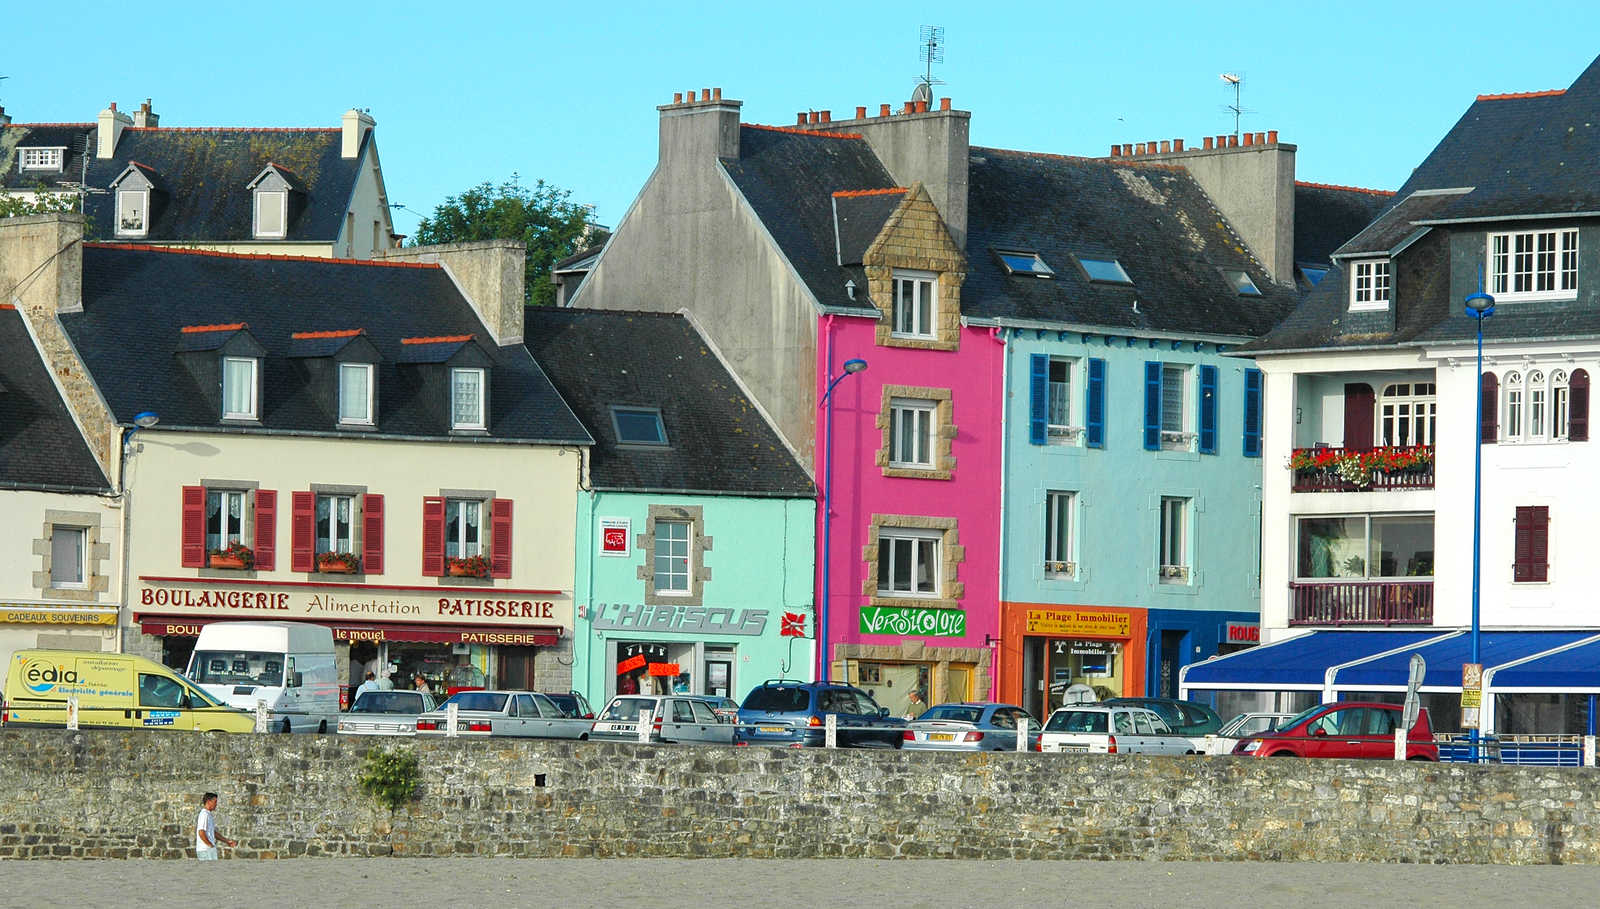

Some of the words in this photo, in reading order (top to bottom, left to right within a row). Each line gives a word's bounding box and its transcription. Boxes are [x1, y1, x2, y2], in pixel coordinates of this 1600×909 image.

[142, 588, 290, 610] BOULANGERIE
[306, 594, 421, 615] Alimentation
[438, 598, 554, 618] PATISSERIE
[7, 613, 47, 621] CADEAUX
[51, 614, 100, 622] SOUVENIRS
[1029, 611, 1041, 620] La
[1046, 612, 1072, 622] Plage
[1076, 613, 1128, 623] Immobilier
[461, 633, 535, 643] PATISSERIE
[28, 664, 78, 683] édia
